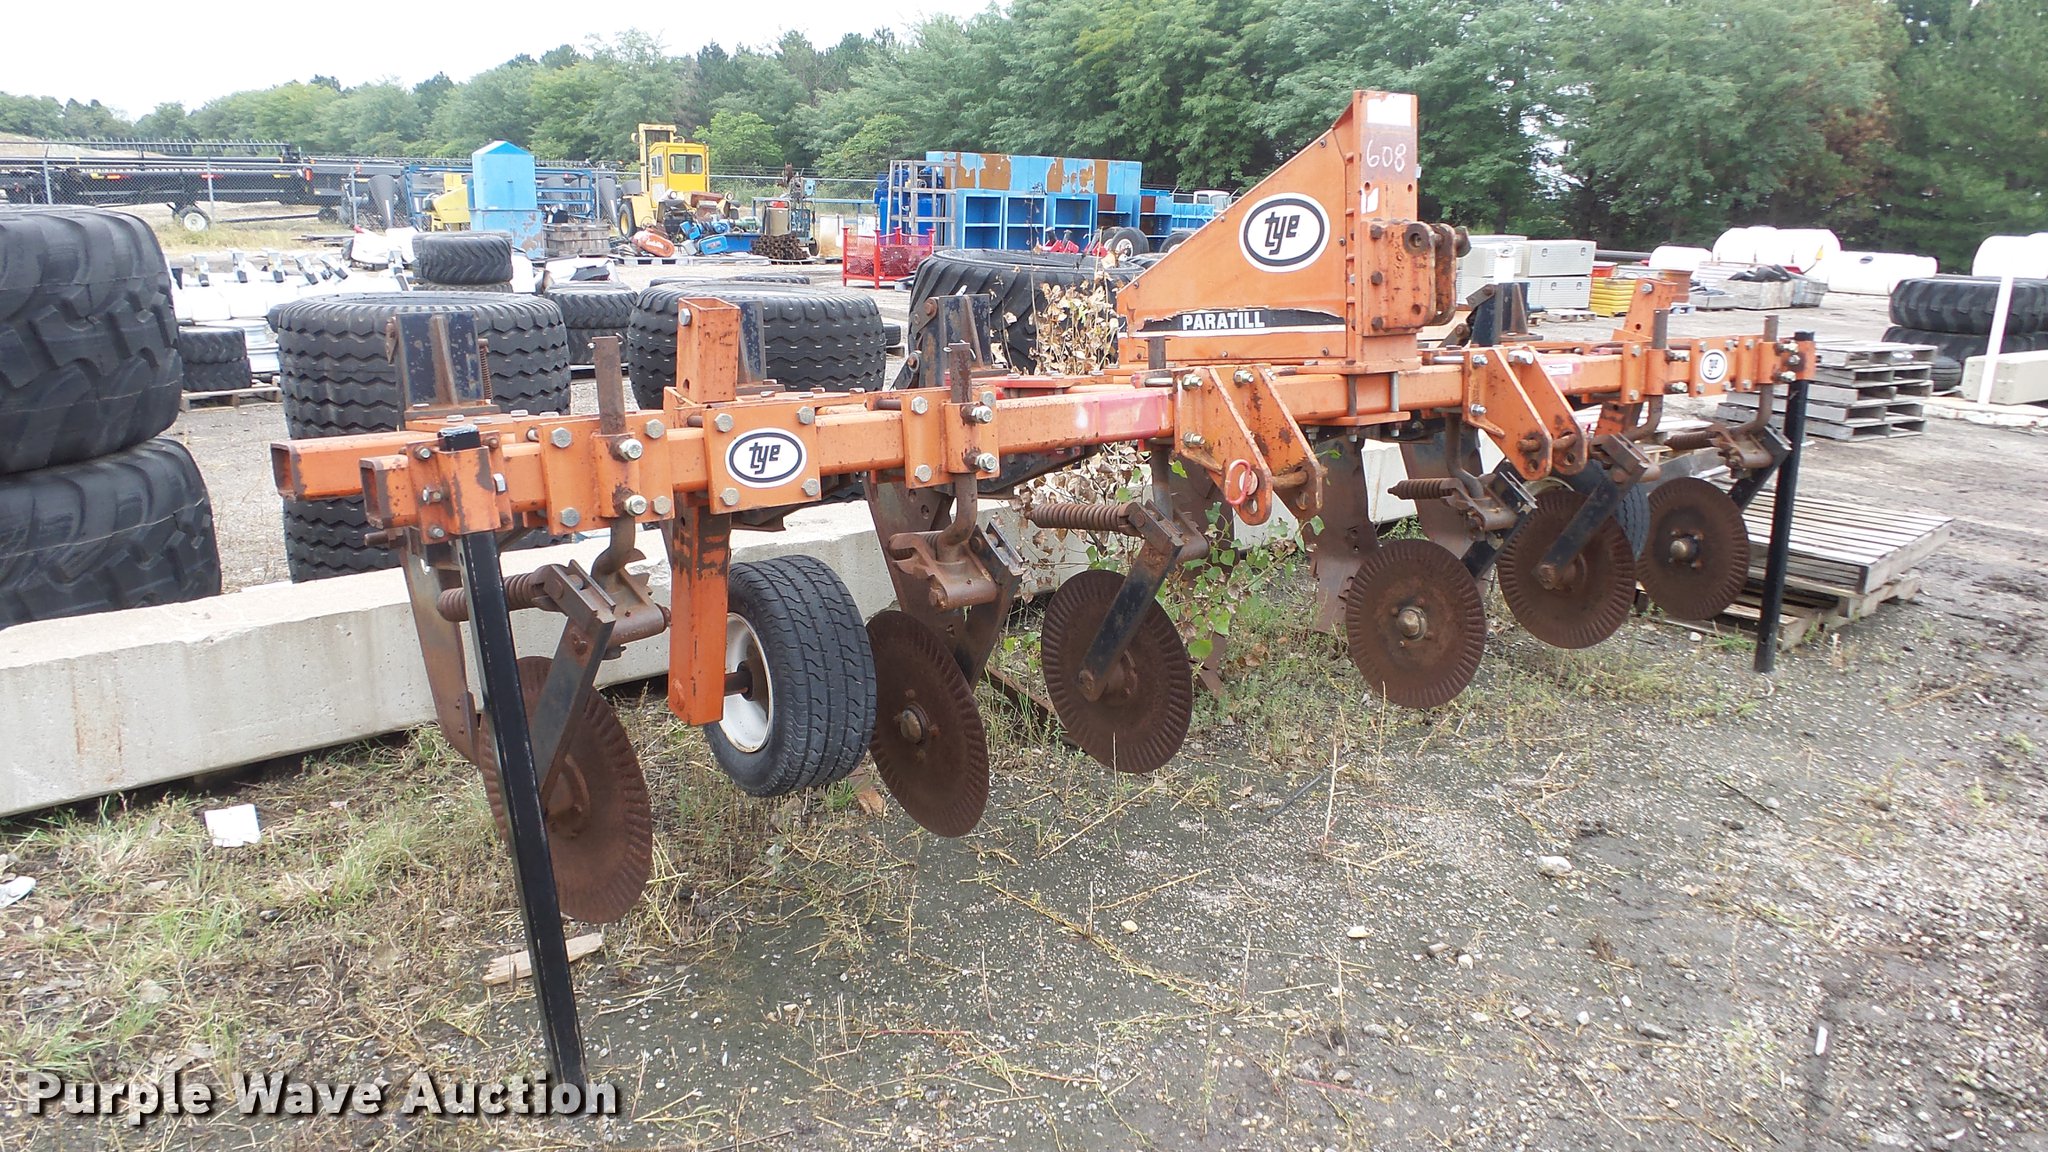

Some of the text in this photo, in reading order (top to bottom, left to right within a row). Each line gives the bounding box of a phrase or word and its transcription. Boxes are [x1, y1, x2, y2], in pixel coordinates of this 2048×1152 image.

[1366, 139, 1407, 173] 608
[1264, 211, 1301, 255] tye
[1182, 311, 1265, 331] PARATILL
[748, 441, 781, 475] tye
